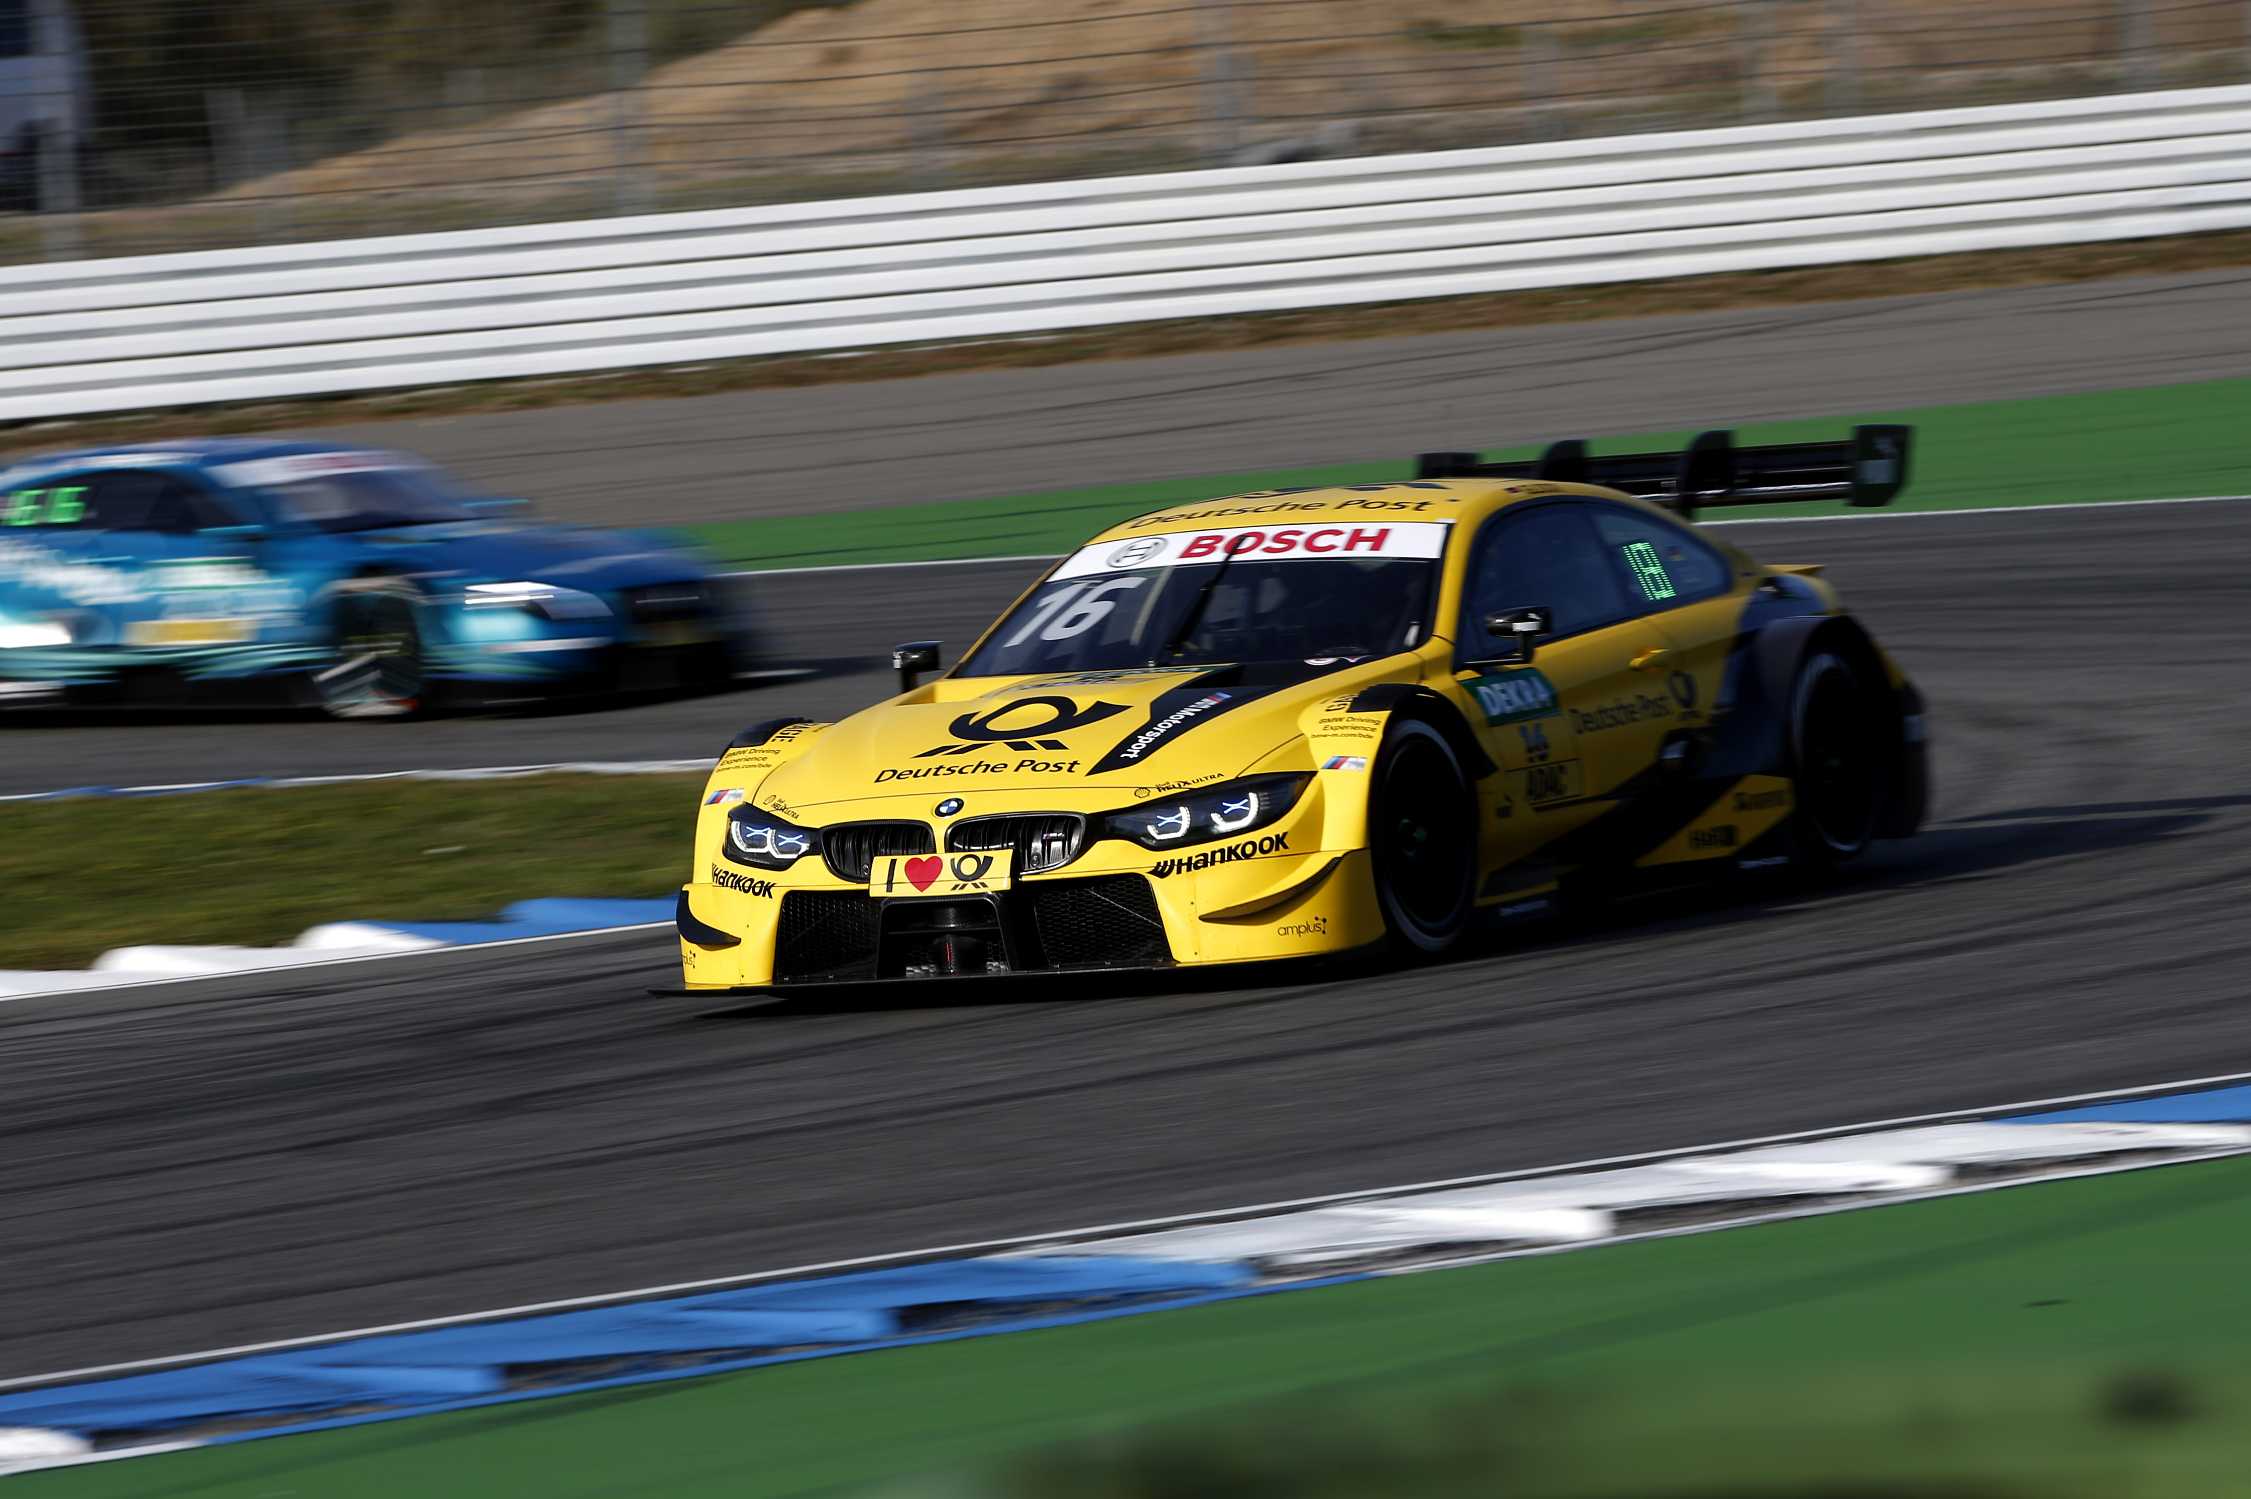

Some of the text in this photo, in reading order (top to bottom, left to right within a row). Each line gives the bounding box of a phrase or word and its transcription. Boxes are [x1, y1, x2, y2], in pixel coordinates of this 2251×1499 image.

[1128, 499, 1434, 529] Deutsche Post
[1177, 527, 1391, 558] BOSCH
[1002, 576, 1147, 648] 16
[1120, 707, 1202, 758] Motorsport
[874, 760, 1080, 783] Deutsche Post
[1192, 773, 1224, 784] ULTRA
[886, 859, 897, 892] I
[1277, 920, 1322, 937] amplus
